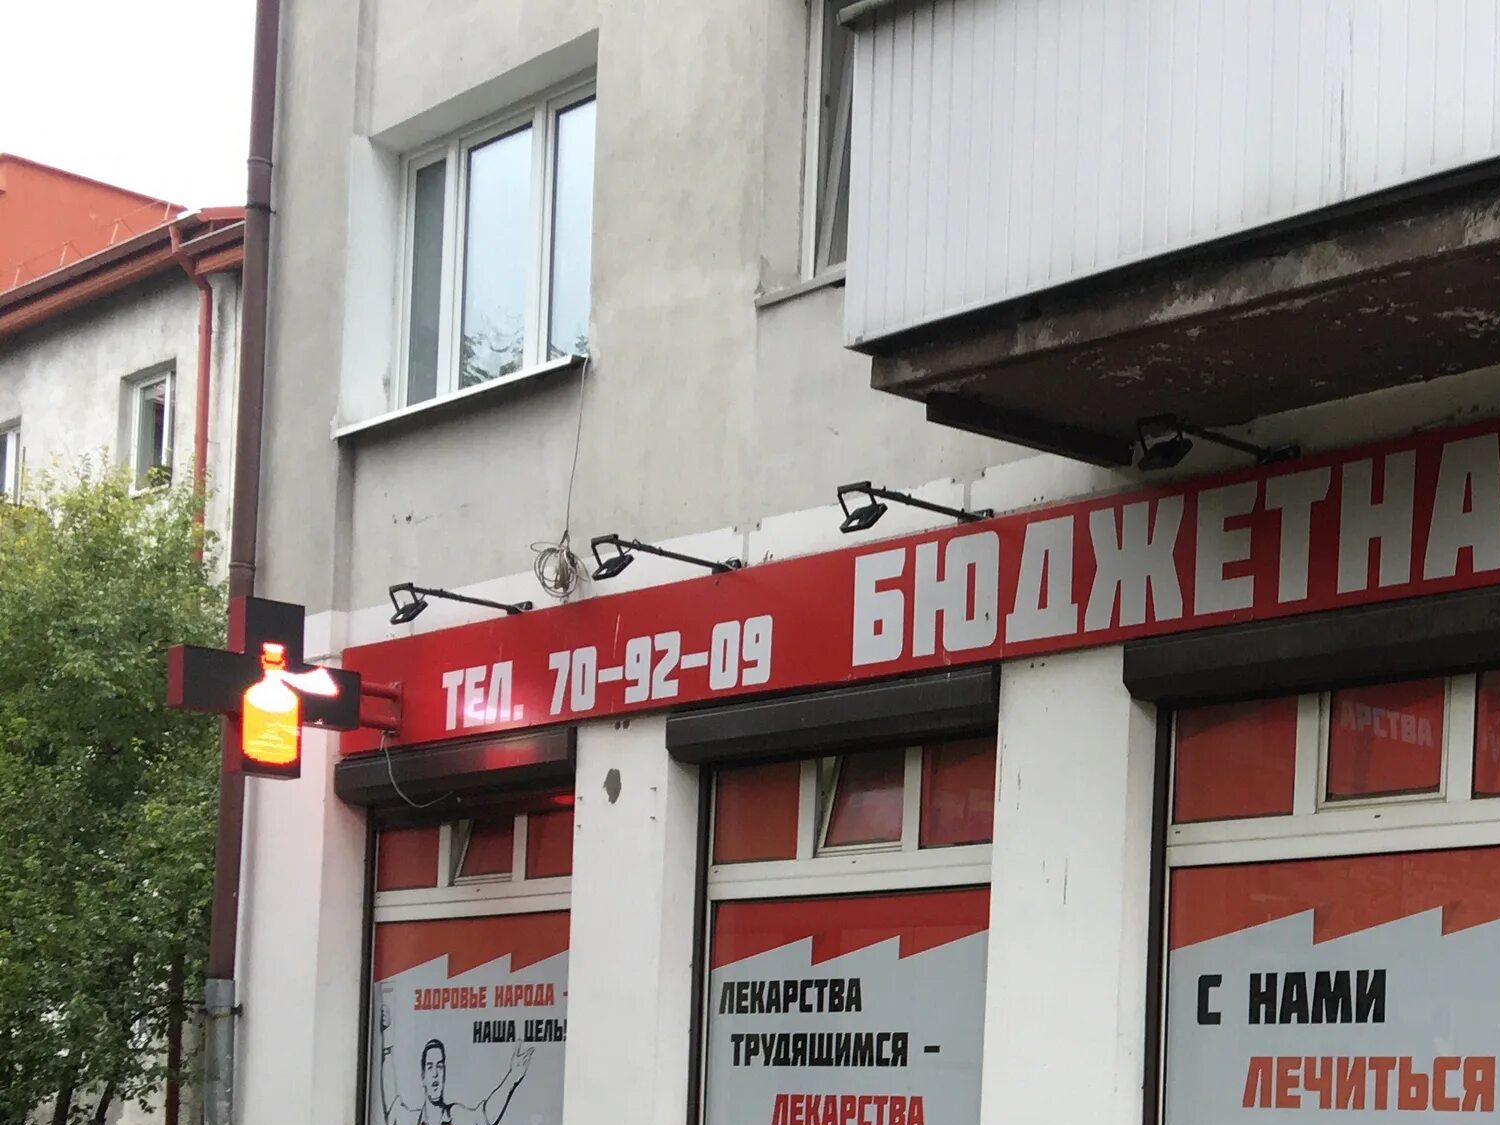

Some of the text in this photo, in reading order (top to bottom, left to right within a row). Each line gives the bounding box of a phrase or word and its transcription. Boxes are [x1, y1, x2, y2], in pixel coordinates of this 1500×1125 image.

[442, 614, 773, 730] ТЕЛ. 70-92-09
[414, 983, 555, 1011] ЗДОРОВЬЕ НАРОДА
[719, 978, 863, 1015] ЛЕКАРСТВА
[1197, 969, 1387, 1025] С НАМИ
[473, 1019, 517, 1043] НАША
[731, 1032, 909, 1067] ТРУДЯЩИМСЯ
[1242, 1056, 1496, 1112] ЛЕЧИТЬСЯ
